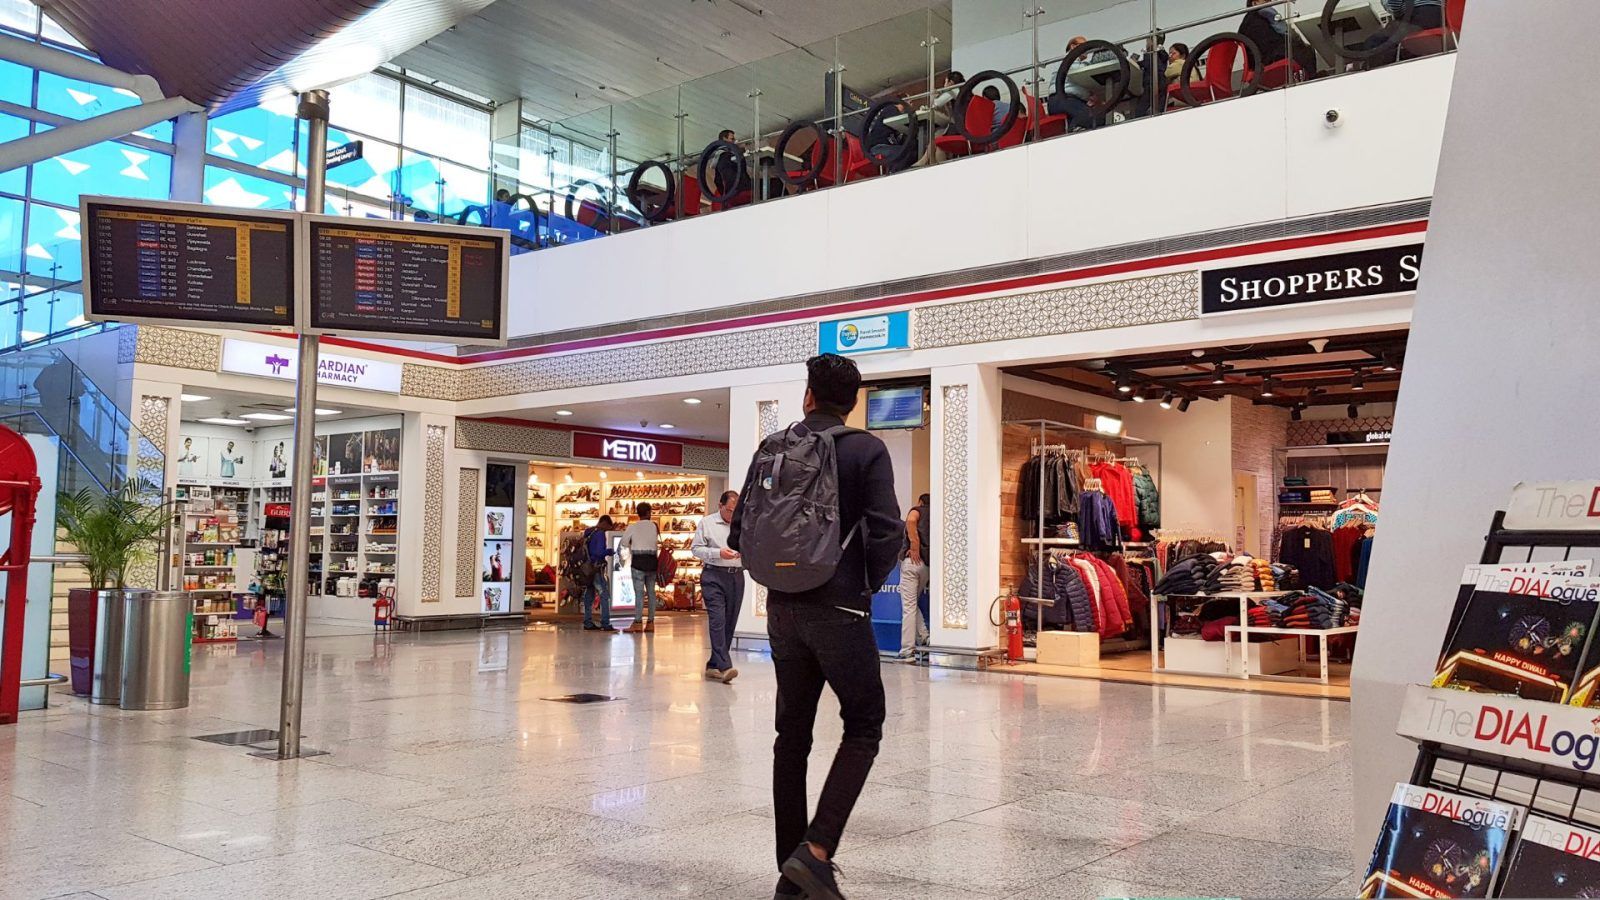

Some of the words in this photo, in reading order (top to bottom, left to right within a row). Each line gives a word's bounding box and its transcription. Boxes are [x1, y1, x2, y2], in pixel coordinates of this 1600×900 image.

[1220, 265, 1383, 303] SHOPPERS
[317, 372, 358, 383] HARMACY
[319, 359, 366, 375] ARDIAN
[1366, 432, 1384, 442] global
[603, 438, 657, 462] METRO
[1536, 487, 1586, 518] The
[879, 584, 901, 593] urre
[1508, 576, 1598, 605] DIALogue
[1494, 652, 1522, 667] HAPPY
[1521, 661, 1547, 676] DIWALI
[1426, 696, 1474, 738] The
[1422, 792, 1507, 831] DIALogue
[1408, 876, 1435, 895] HAPPY
